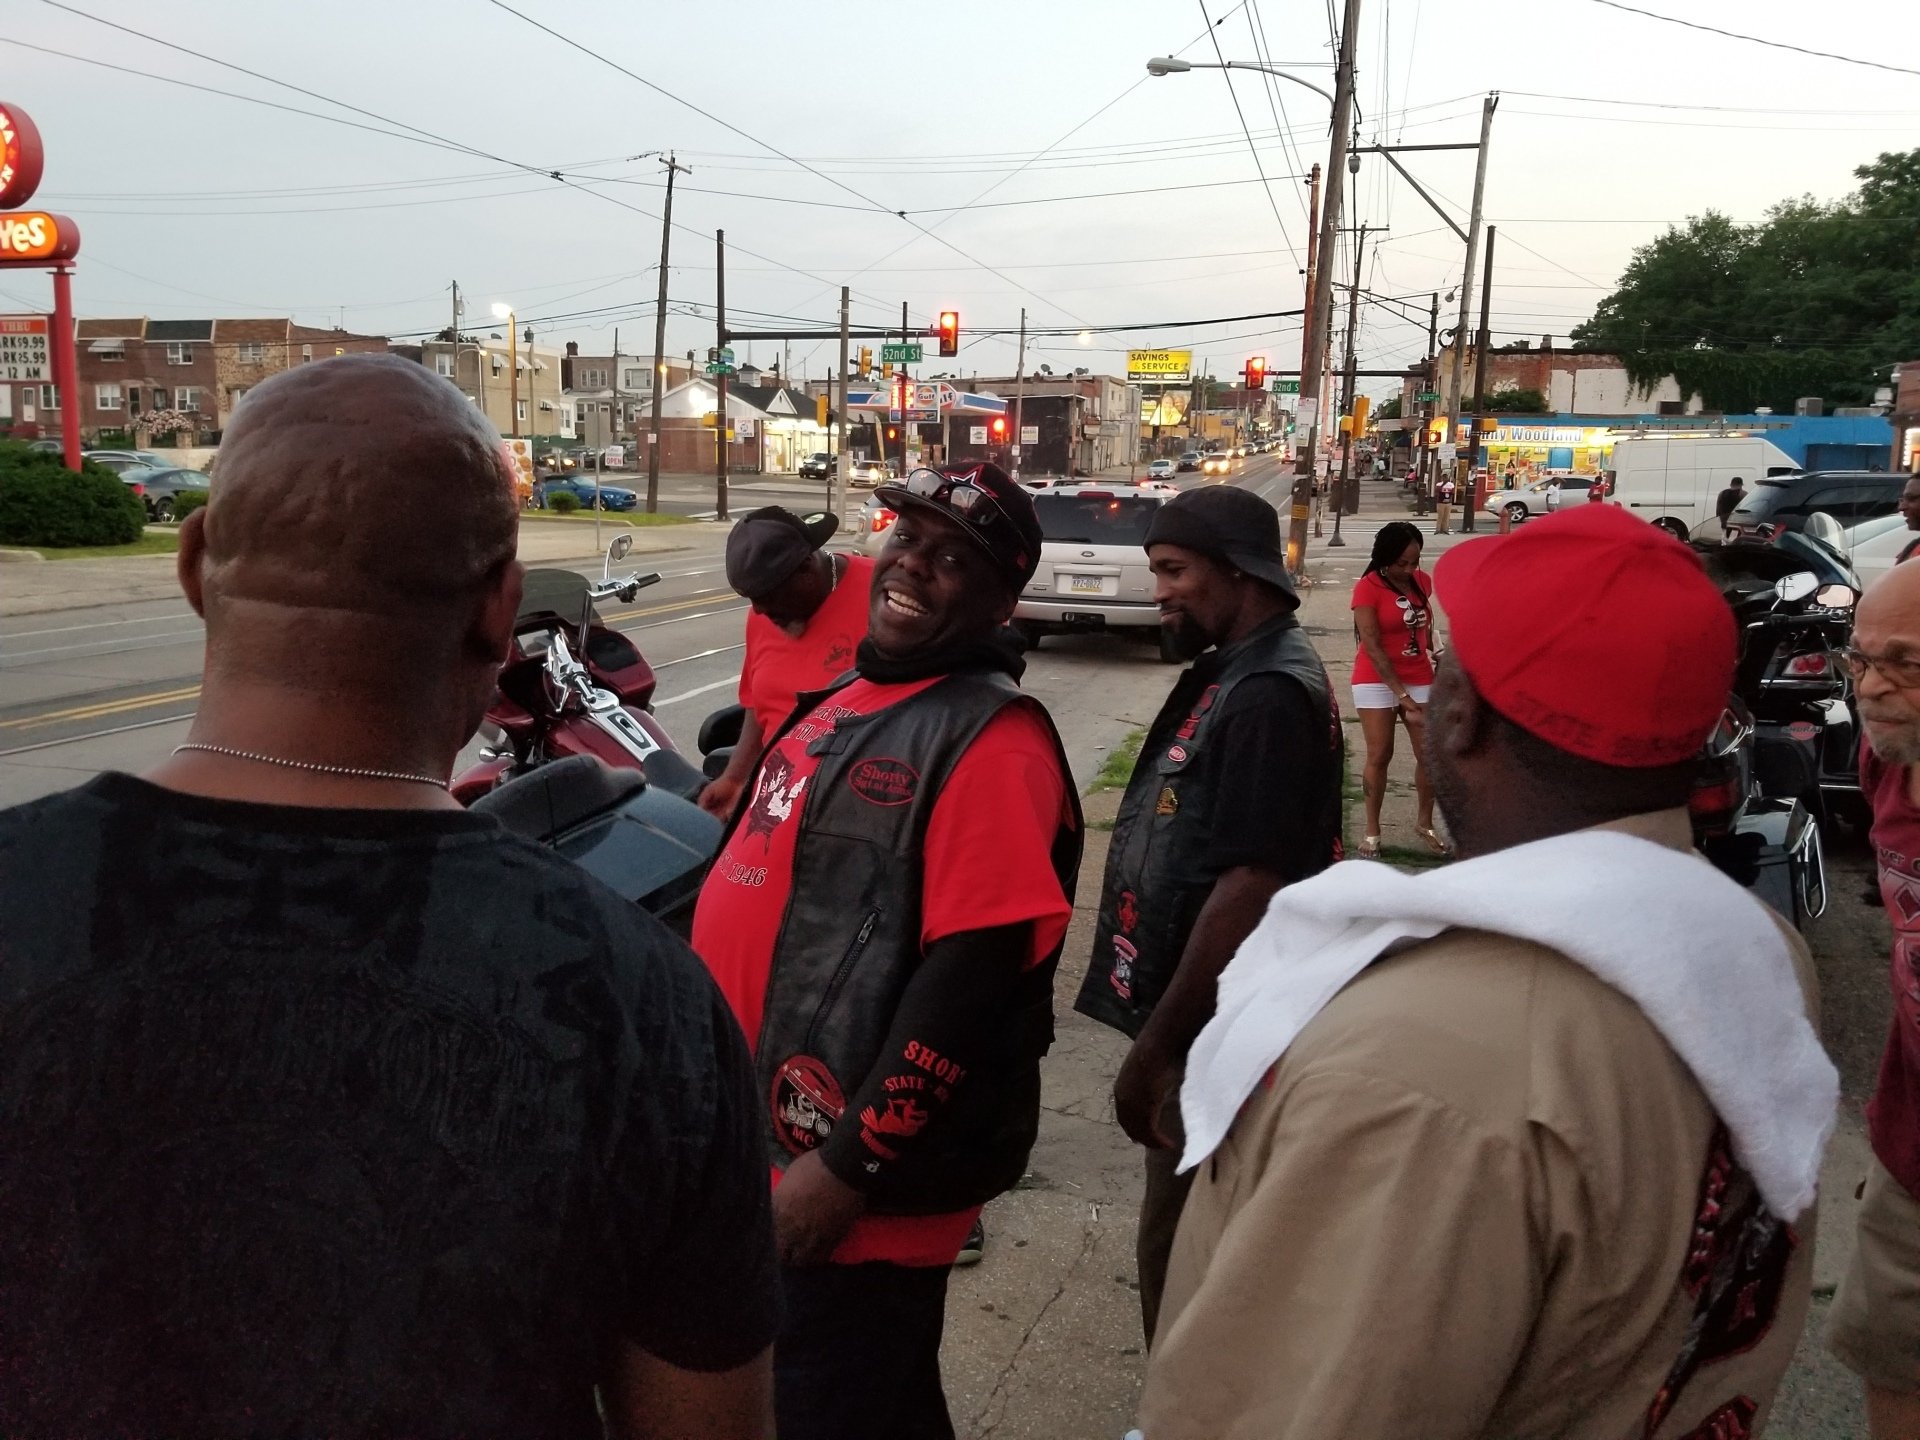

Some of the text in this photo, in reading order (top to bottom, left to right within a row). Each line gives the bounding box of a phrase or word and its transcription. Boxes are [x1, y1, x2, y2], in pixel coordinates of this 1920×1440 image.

[884, 348, 921, 360] 52nd St
[1131, 353, 1169, 361] SAVINGS
[26, 367, 41, 379] AM
[1273, 382, 1292, 392] 52nd
[1511, 427, 1584, 442] Woodland
[606, 457, 622, 465] OPEN
[860, 763, 911, 786] Shorty
[727, 862, 768, 887] 1946
[904, 1040, 967, 1084] SHOR
[884, 1074, 926, 1092] STATE
